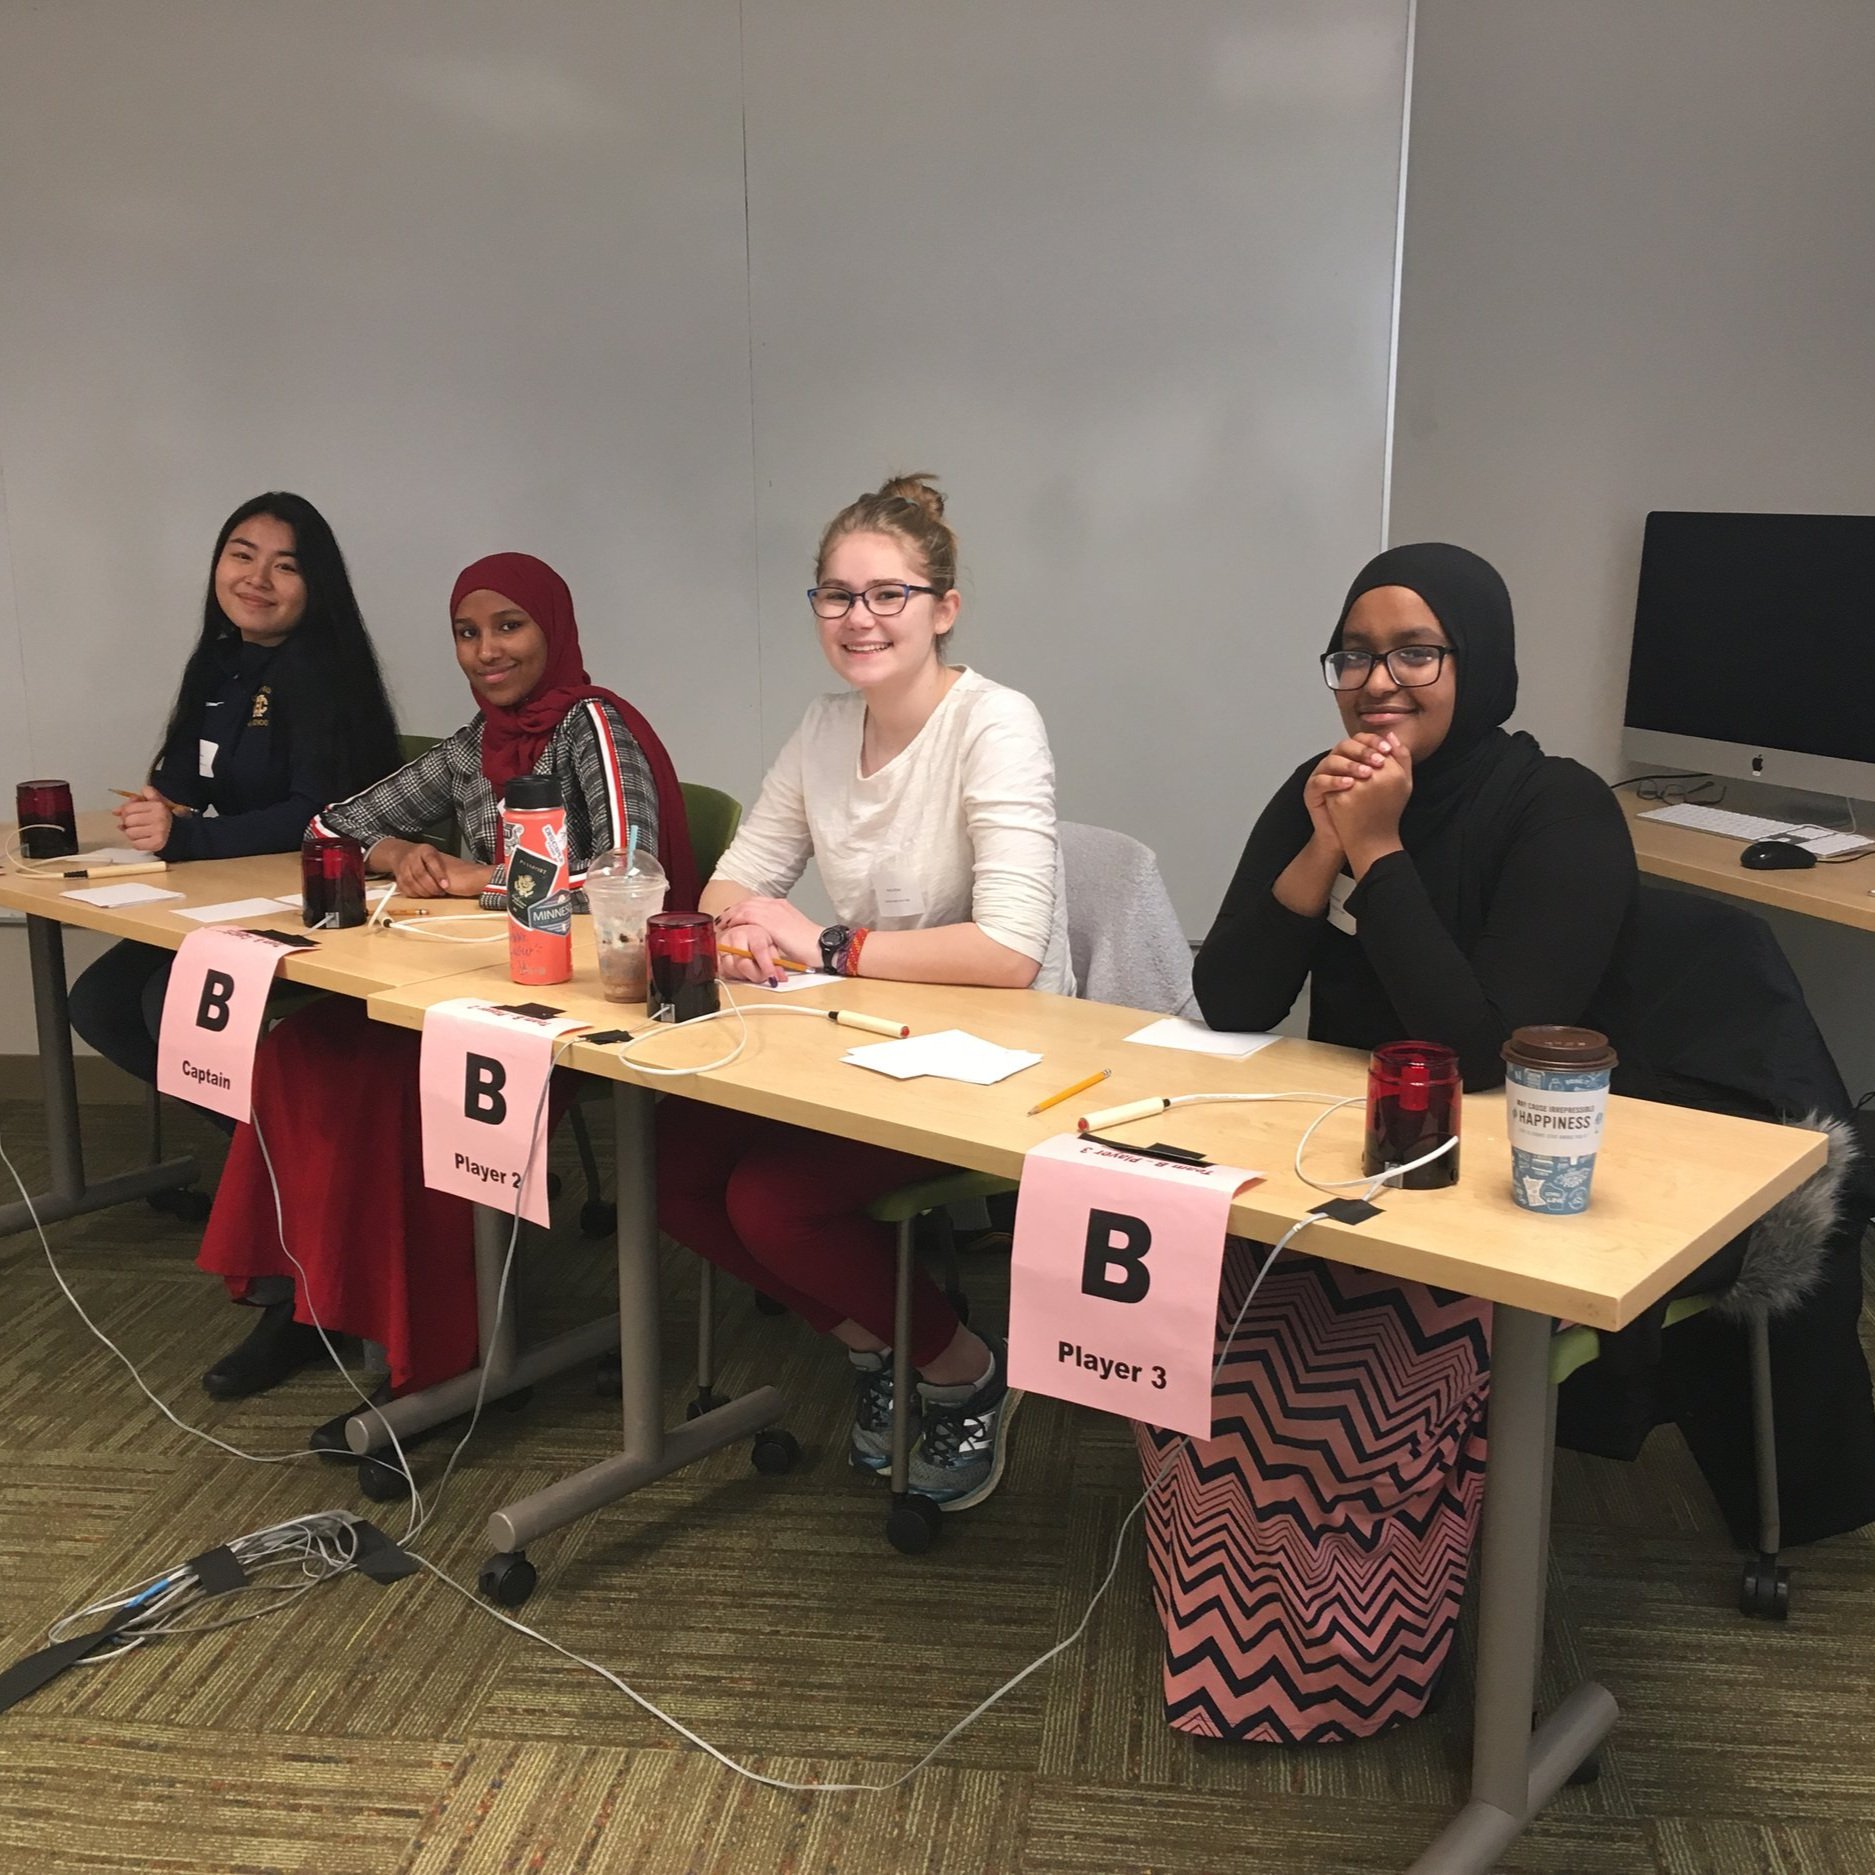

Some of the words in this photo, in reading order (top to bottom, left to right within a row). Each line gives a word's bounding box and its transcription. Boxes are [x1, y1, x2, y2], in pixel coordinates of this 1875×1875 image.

[196, 968, 235, 1032] B
[182, 1060, 231, 1090] Captain
[464, 1051, 507, 1126] B
[1518, 1110, 1592, 1129] HAPPINESS
[455, 1152, 507, 1182] Player
[511, 1172, 521, 1189] 2
[1081, 1208, 1152, 1304] B
[1058, 1341, 1142, 1382] Player
[1151, 1366, 1167, 1390] 3
